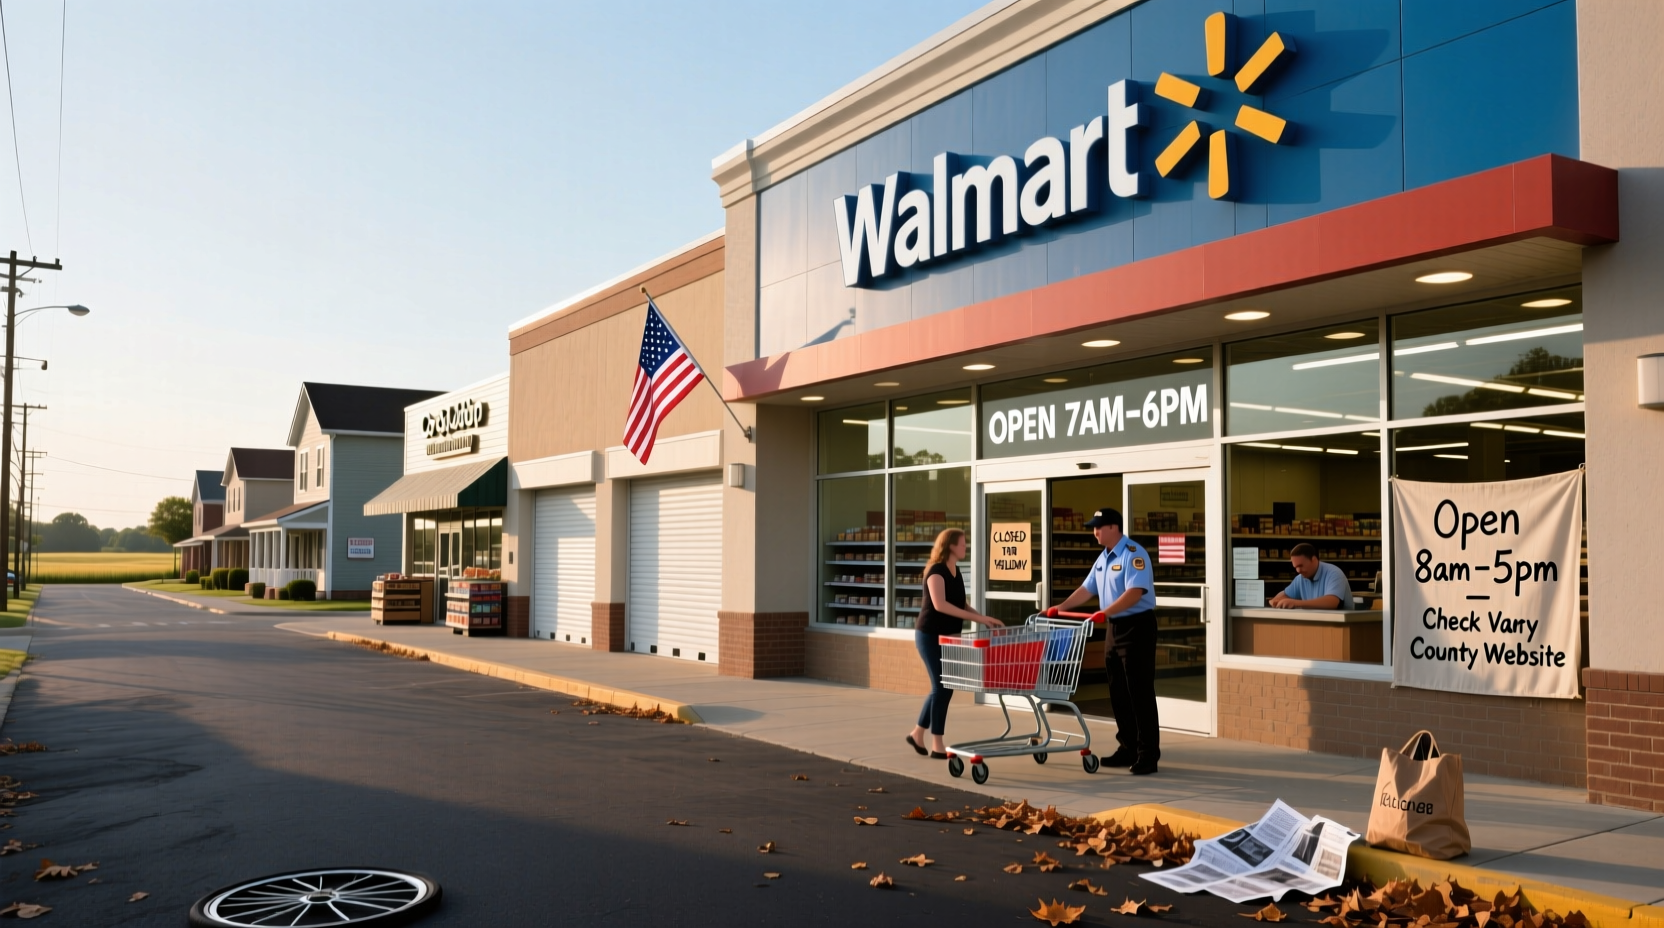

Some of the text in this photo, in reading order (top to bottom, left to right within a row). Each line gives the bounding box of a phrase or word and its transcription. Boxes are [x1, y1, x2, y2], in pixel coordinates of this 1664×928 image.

[834, 79, 1139, 287] Walmart
[989, 404, 1056, 445] OPEN
[1434, 499, 1520, 550] Open
[1423, 607, 1481, 632] Check
[1410, 636, 1566, 670] County Website
